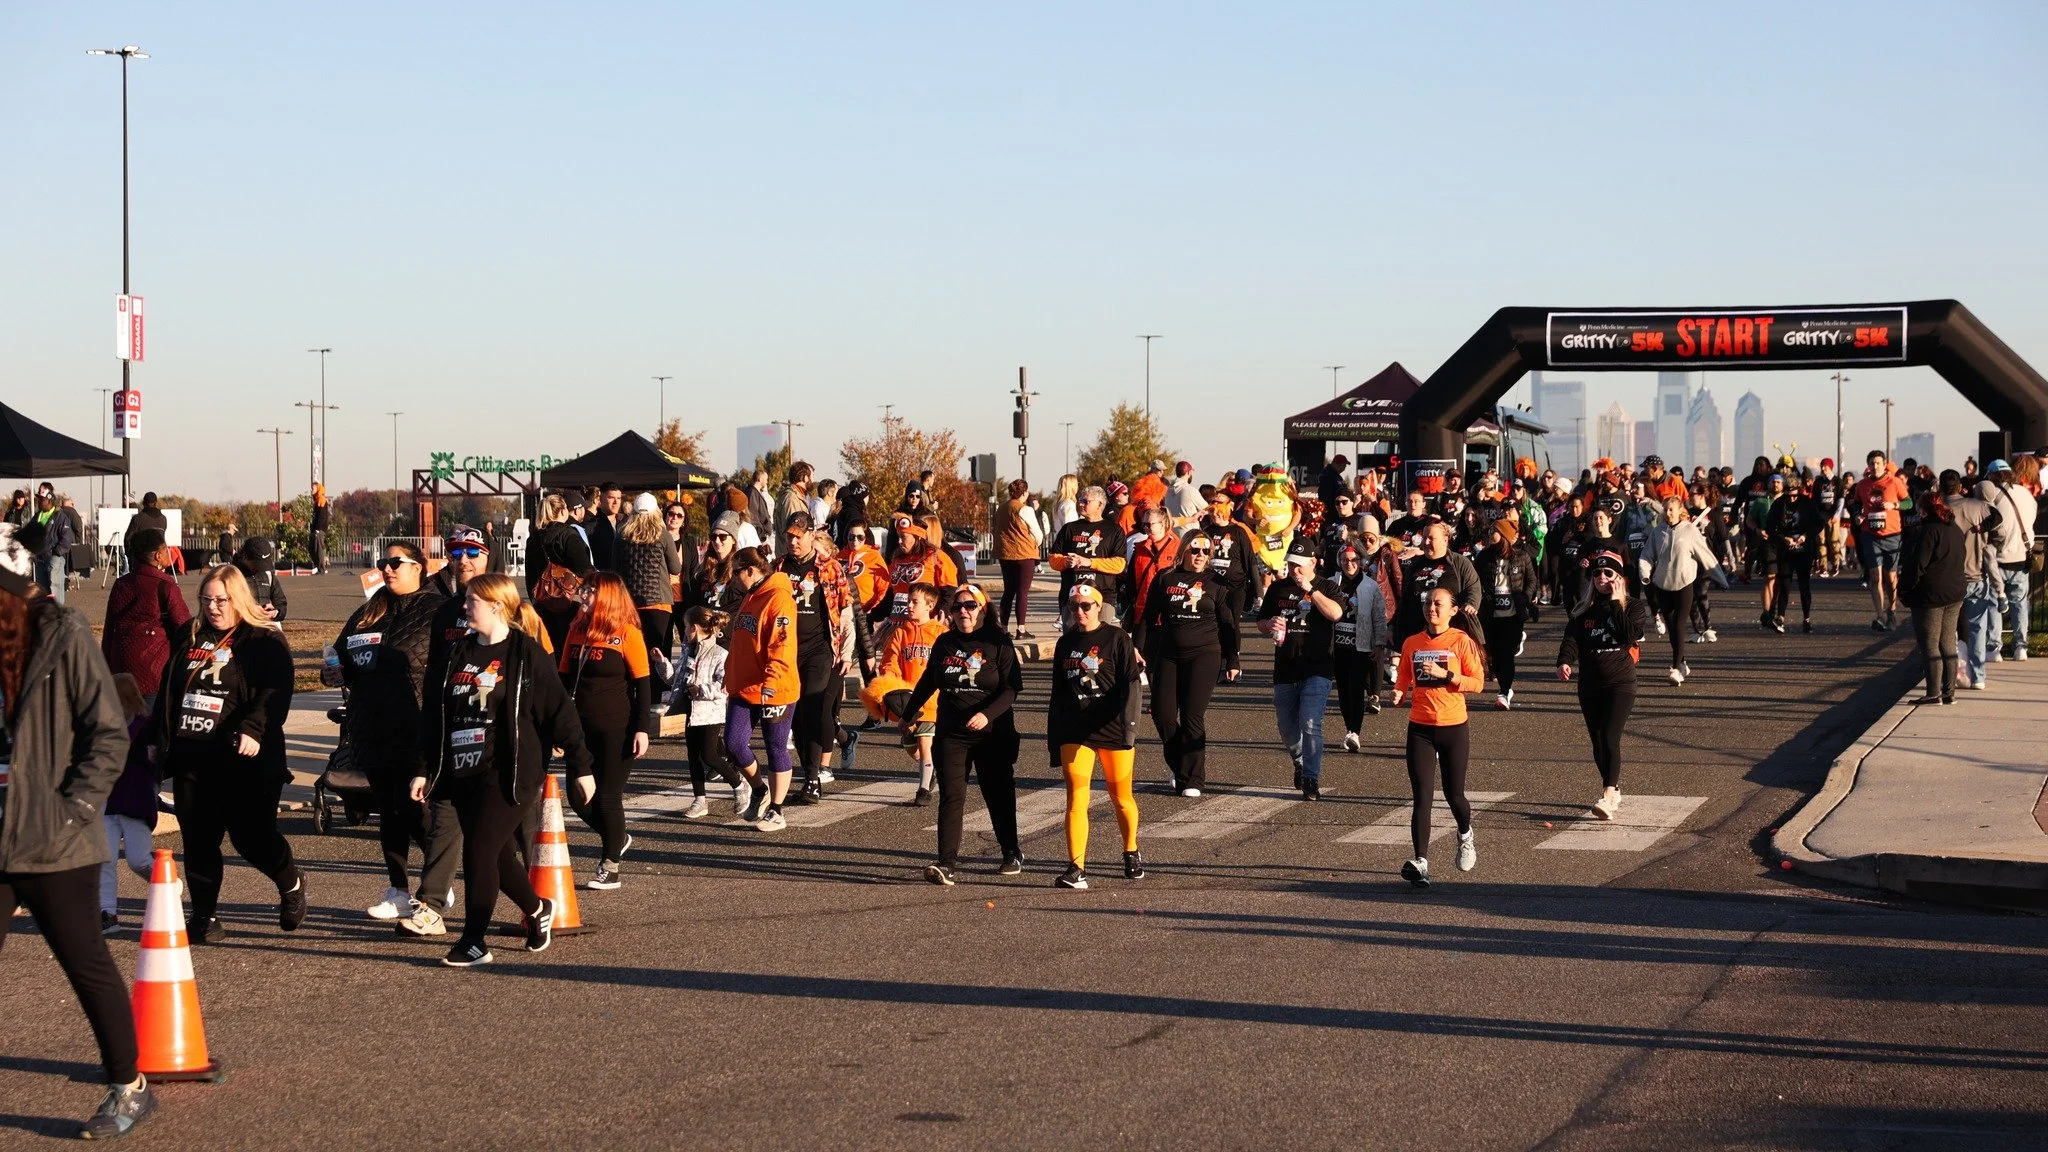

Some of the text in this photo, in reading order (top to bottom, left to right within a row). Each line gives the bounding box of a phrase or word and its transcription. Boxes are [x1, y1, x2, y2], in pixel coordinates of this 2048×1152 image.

[1562, 331, 1665, 351] GRITTY 5K
[1676, 317, 1774, 357] START
[1783, 327, 1888, 348] GRITTY 5K
[114, 394, 125, 406] G2
[128, 394, 140, 406] G2
[1353, 399, 1392, 408] SVE
[463, 455, 536, 474] Citizens
[1415, 469, 1440, 477] GRITTY
[1336, 634, 1356, 644] 2260
[353, 651, 372, 666] 469
[762, 705, 787, 718] 1247
[181, 714, 215, 733] 1459
[454, 751, 482, 769] 1797
